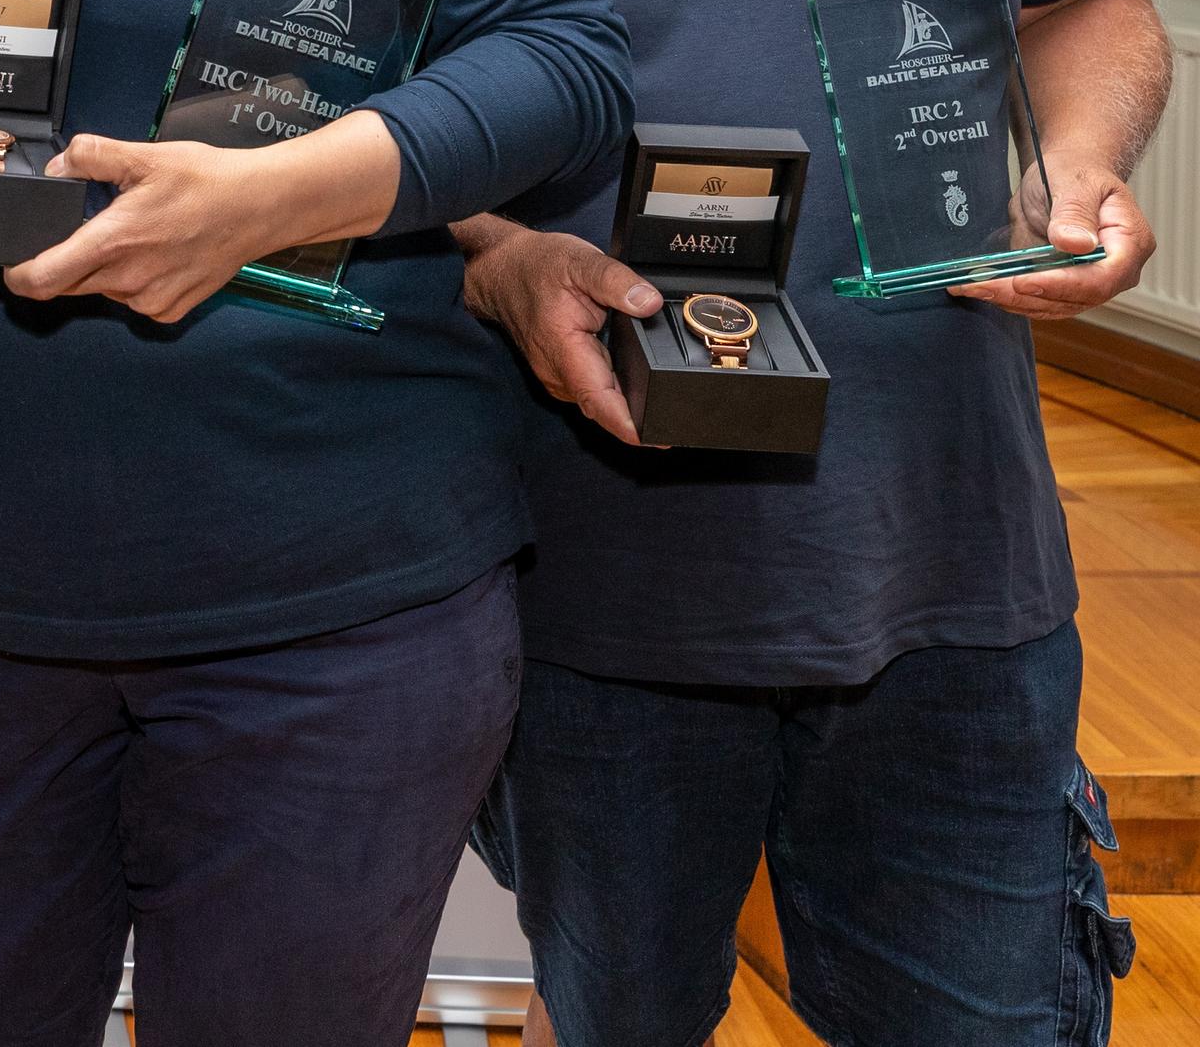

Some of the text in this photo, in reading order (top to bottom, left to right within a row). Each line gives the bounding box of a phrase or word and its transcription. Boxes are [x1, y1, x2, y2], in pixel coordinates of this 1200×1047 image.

[235, 20, 377, 74] BALTIC SEA RACE
[283, 20, 342, 48] ROSCHIER
[199, 60, 249, 92] IRC
[866, 58, 990, 88] BALTIC SEA RACE
[901, 53, 953, 70] ROSCHIER
[228, 102, 313, 140] 1st Over
[909, 100, 964, 125] IRC 2
[895, 120, 990, 152] 2nd Overall
[697, 204, 730, 212] AARNI
[670, 233, 737, 249] AARNI
